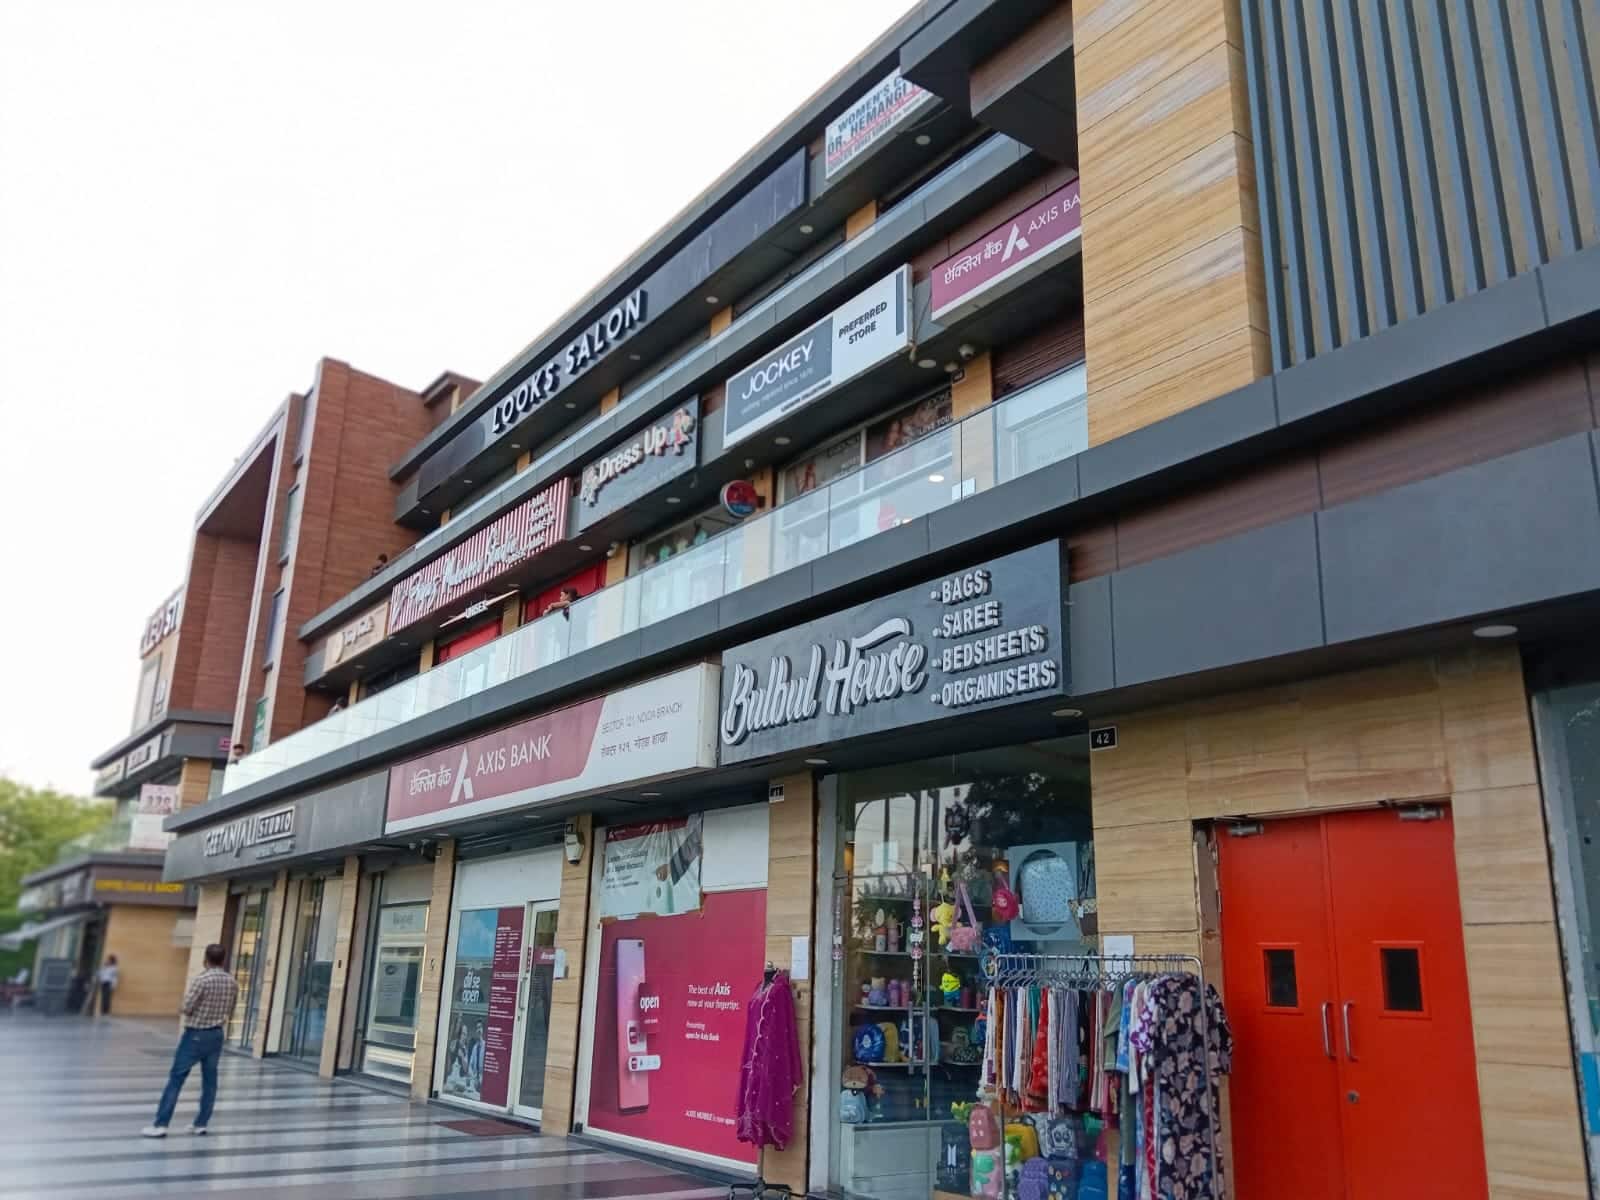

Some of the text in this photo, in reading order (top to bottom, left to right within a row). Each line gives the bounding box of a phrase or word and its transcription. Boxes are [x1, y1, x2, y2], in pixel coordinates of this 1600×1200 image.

[838, 84, 890, 132] WOMEN'S
[850, 82, 907, 138] HEMANGI
[1027, 193, 1080, 235] AXIS BA
[838, 301, 888, 339] PREFERRED
[848, 320, 877, 345] STORE
[492, 288, 646, 434] LOOKS SALON
[741, 338, 814, 401] JOCKEY
[598, 443, 641, 483] Dress
[644, 426, 667, 457] Up
[942, 569, 989, 604] BAGS
[942, 600, 999, 638] SAREE
[942, 624, 1046, 673] BEDSHEETS
[721, 617, 929, 745] Bulbul House
[941, 659, 1056, 706] ORGANISERS
[656, 702, 682, 719] BRANCH
[475, 733, 553, 777] AXIS BANK
[1096, 732, 1110, 745] 42
[258, 811, 293, 838] STUDIO
[462, 989, 480, 1005] open
[640, 996, 659, 1013] open
[687, 984, 697, 994] The
[698, 984, 708, 995] best
[714, 981, 731, 996] Axis
